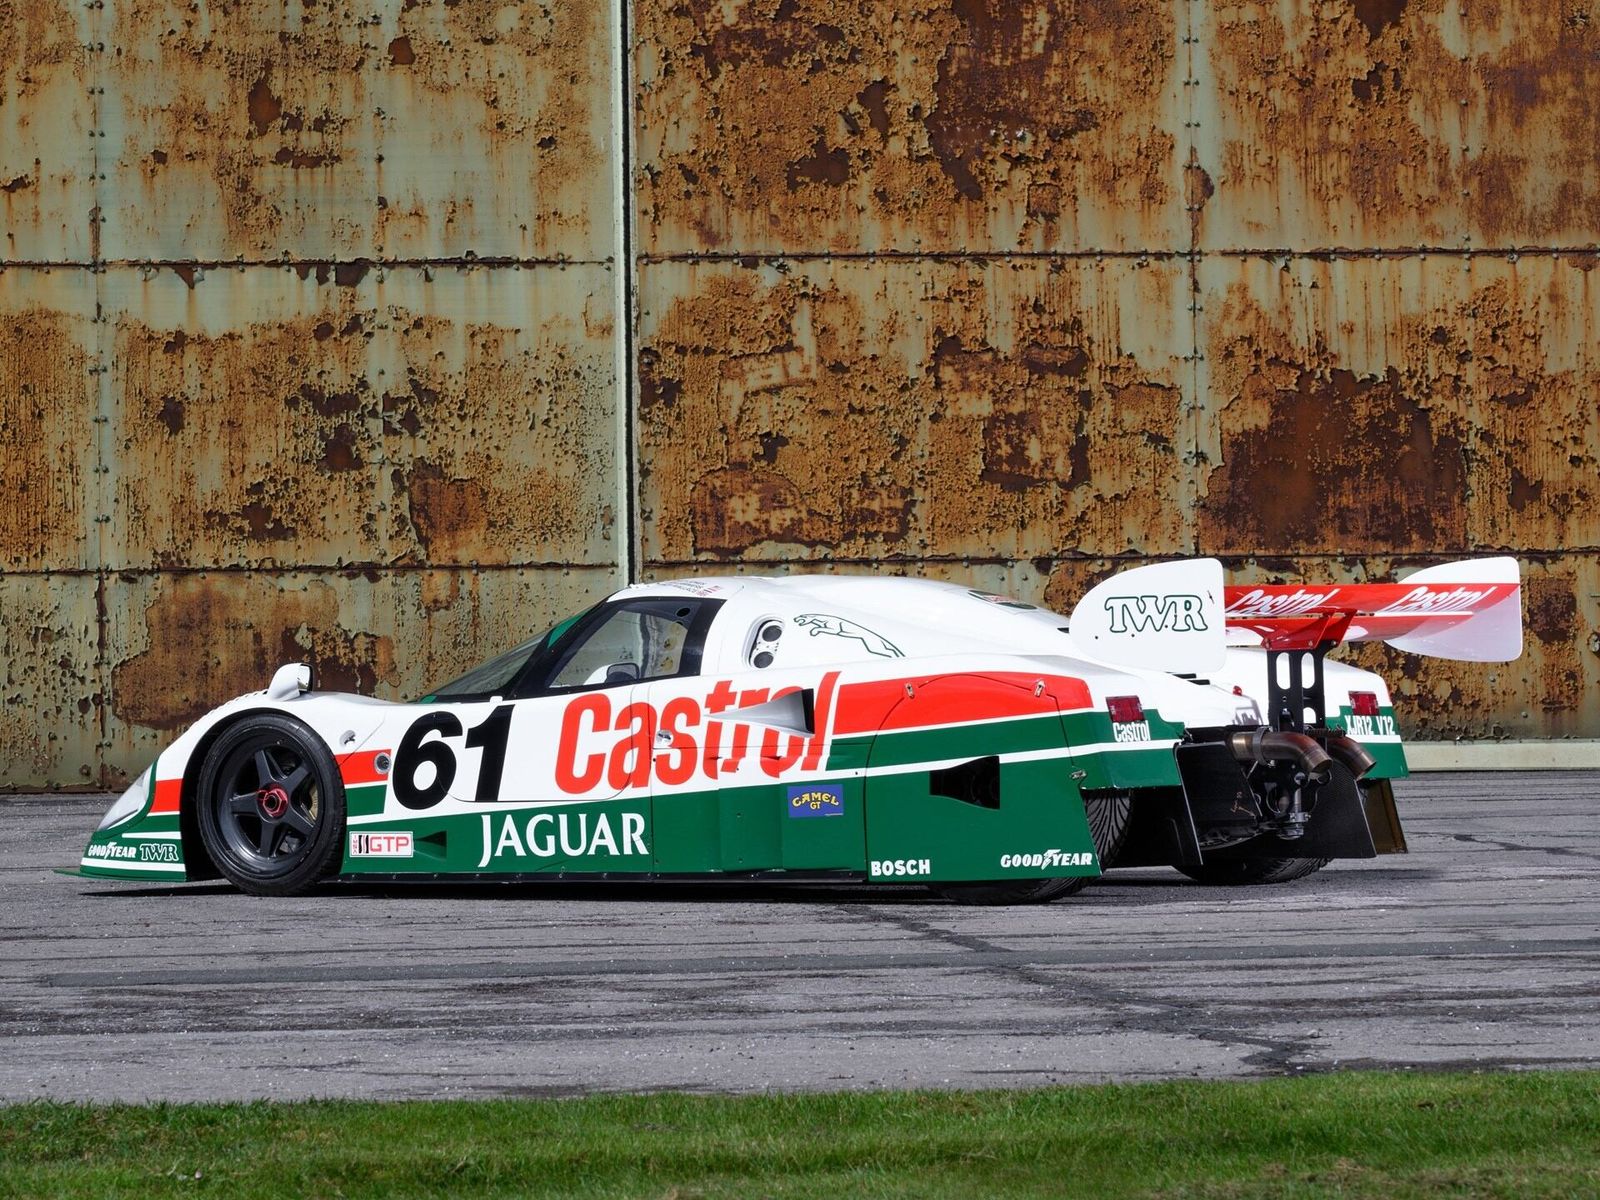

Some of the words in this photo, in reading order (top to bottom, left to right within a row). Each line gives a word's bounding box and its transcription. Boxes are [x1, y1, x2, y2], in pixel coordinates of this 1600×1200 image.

[1225, 588, 1341, 616] Castrol
[1376, 585, 1498, 614] Castrol
[1104, 594, 1208, 633] TWR
[555, 671, 842, 794] Castrol
[1112, 720, 1151, 742] Castrol
[1376, 715, 1396, 735] V12
[392, 704, 516, 809] 61
[792, 792, 839, 807] CAMEL
[810, 801, 821, 810] GT
[370, 836, 410, 852] GTP
[477, 812, 649, 868] JAGUAR
[140, 843, 179, 861] TWR
[1000, 849, 1093, 870] GOODYEAR
[871, 859, 931, 877] BOSCH
